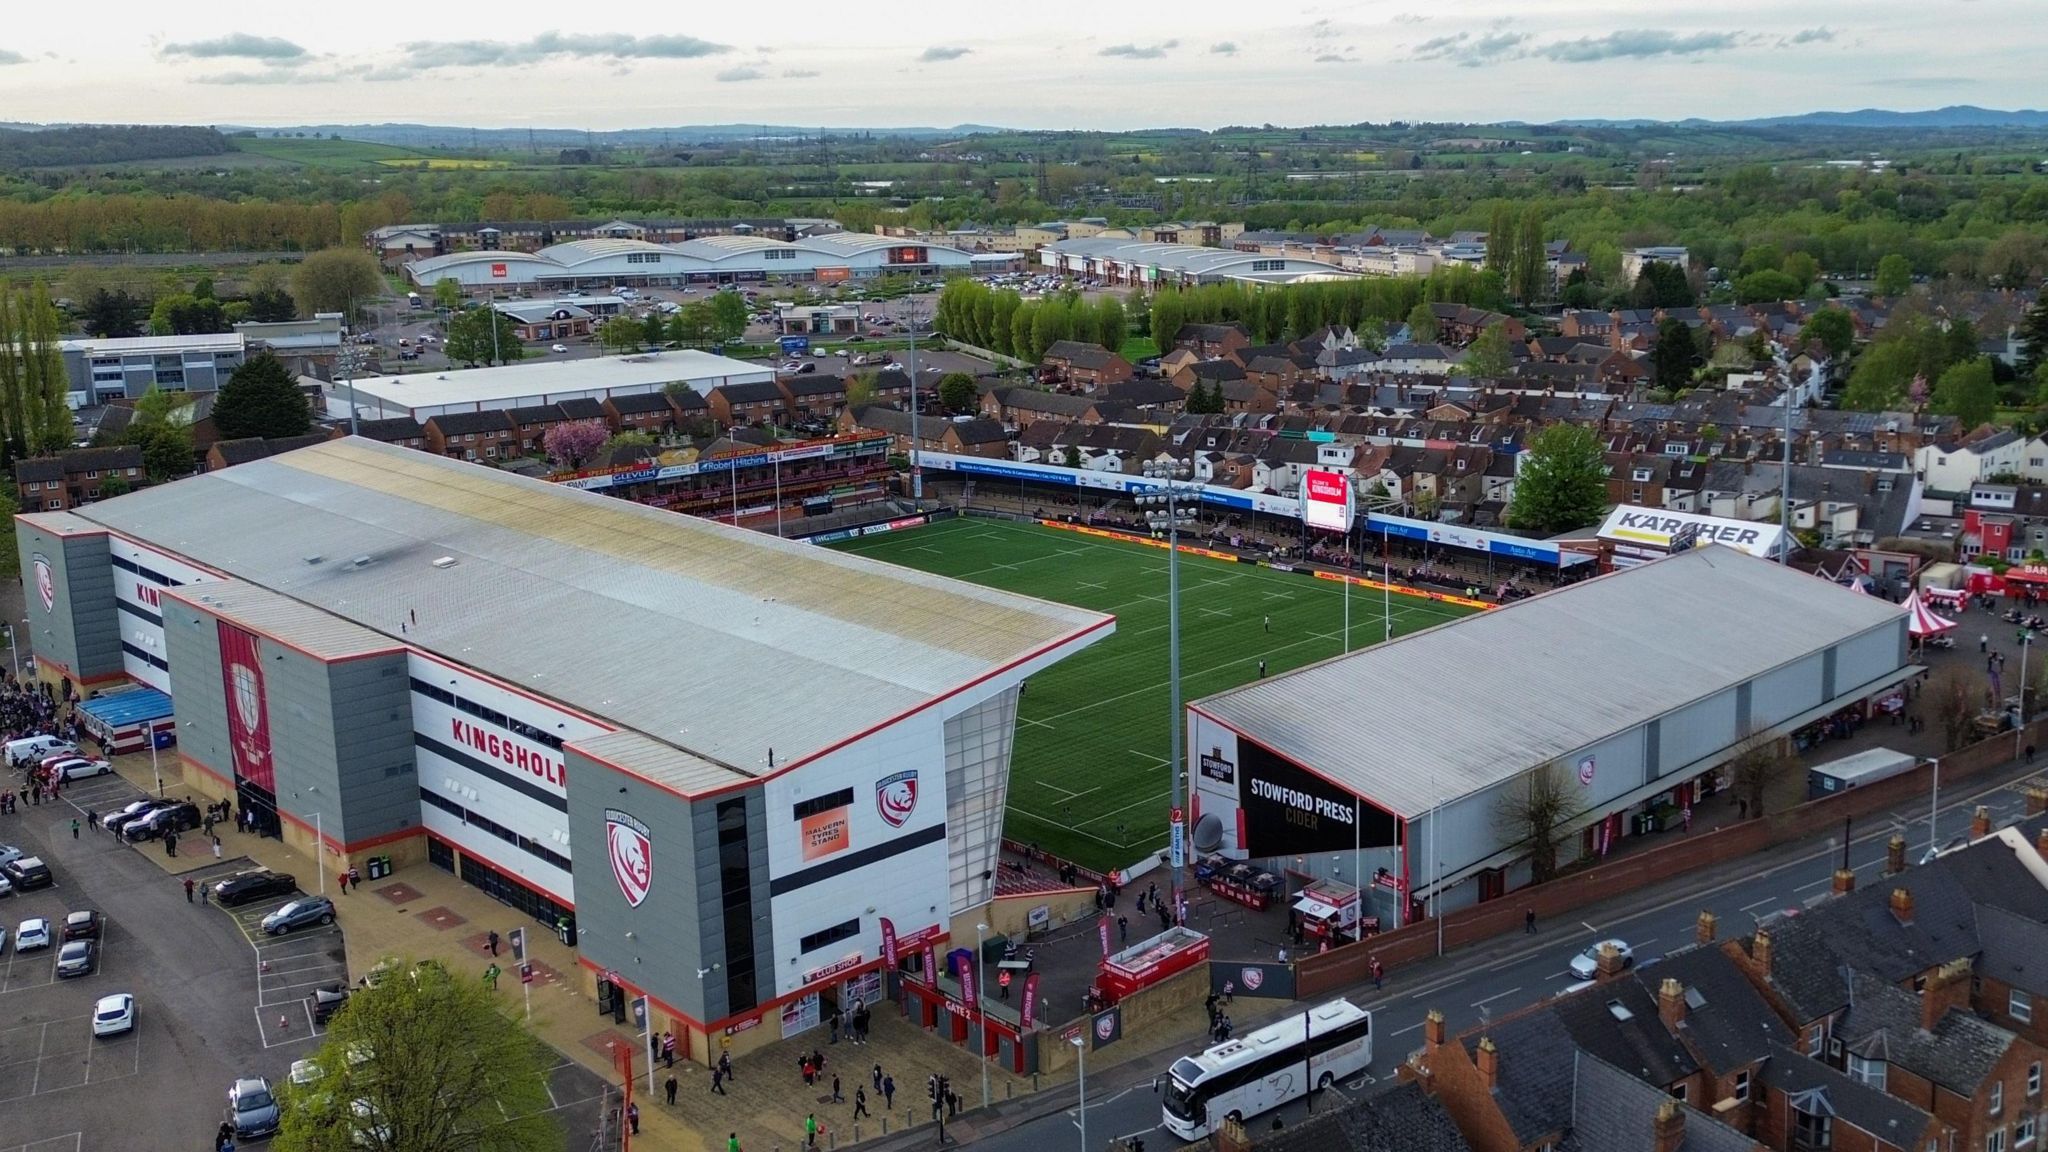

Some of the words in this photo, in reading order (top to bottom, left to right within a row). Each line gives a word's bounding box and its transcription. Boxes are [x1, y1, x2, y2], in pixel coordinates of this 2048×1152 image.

[736, 456, 766, 468] Hitchins
[613, 470, 656, 481] GLEVUM
[1510, 546, 1524, 554] Auto
[2024, 564, 2048, 576] BAR
[136, 582, 160, 608] KIN
[1203, 758, 1232, 774] STOWFORD
[1210, 769, 1225, 778] PRESS
[1251, 778, 1312, 812] STOWFORD
[1316, 798, 1354, 824] PRESS
[1286, 807, 1318, 830] CIDER
[806, 820, 845, 836] MALVERN
[812, 828, 839, 840] TYRES
[811, 834, 840, 848] STAND
[816, 966, 836, 978] CLUB
[838, 956, 858, 970] SHOP
[946, 1000, 965, 1017] GATE
[966, 1009, 971, 1020] 2
